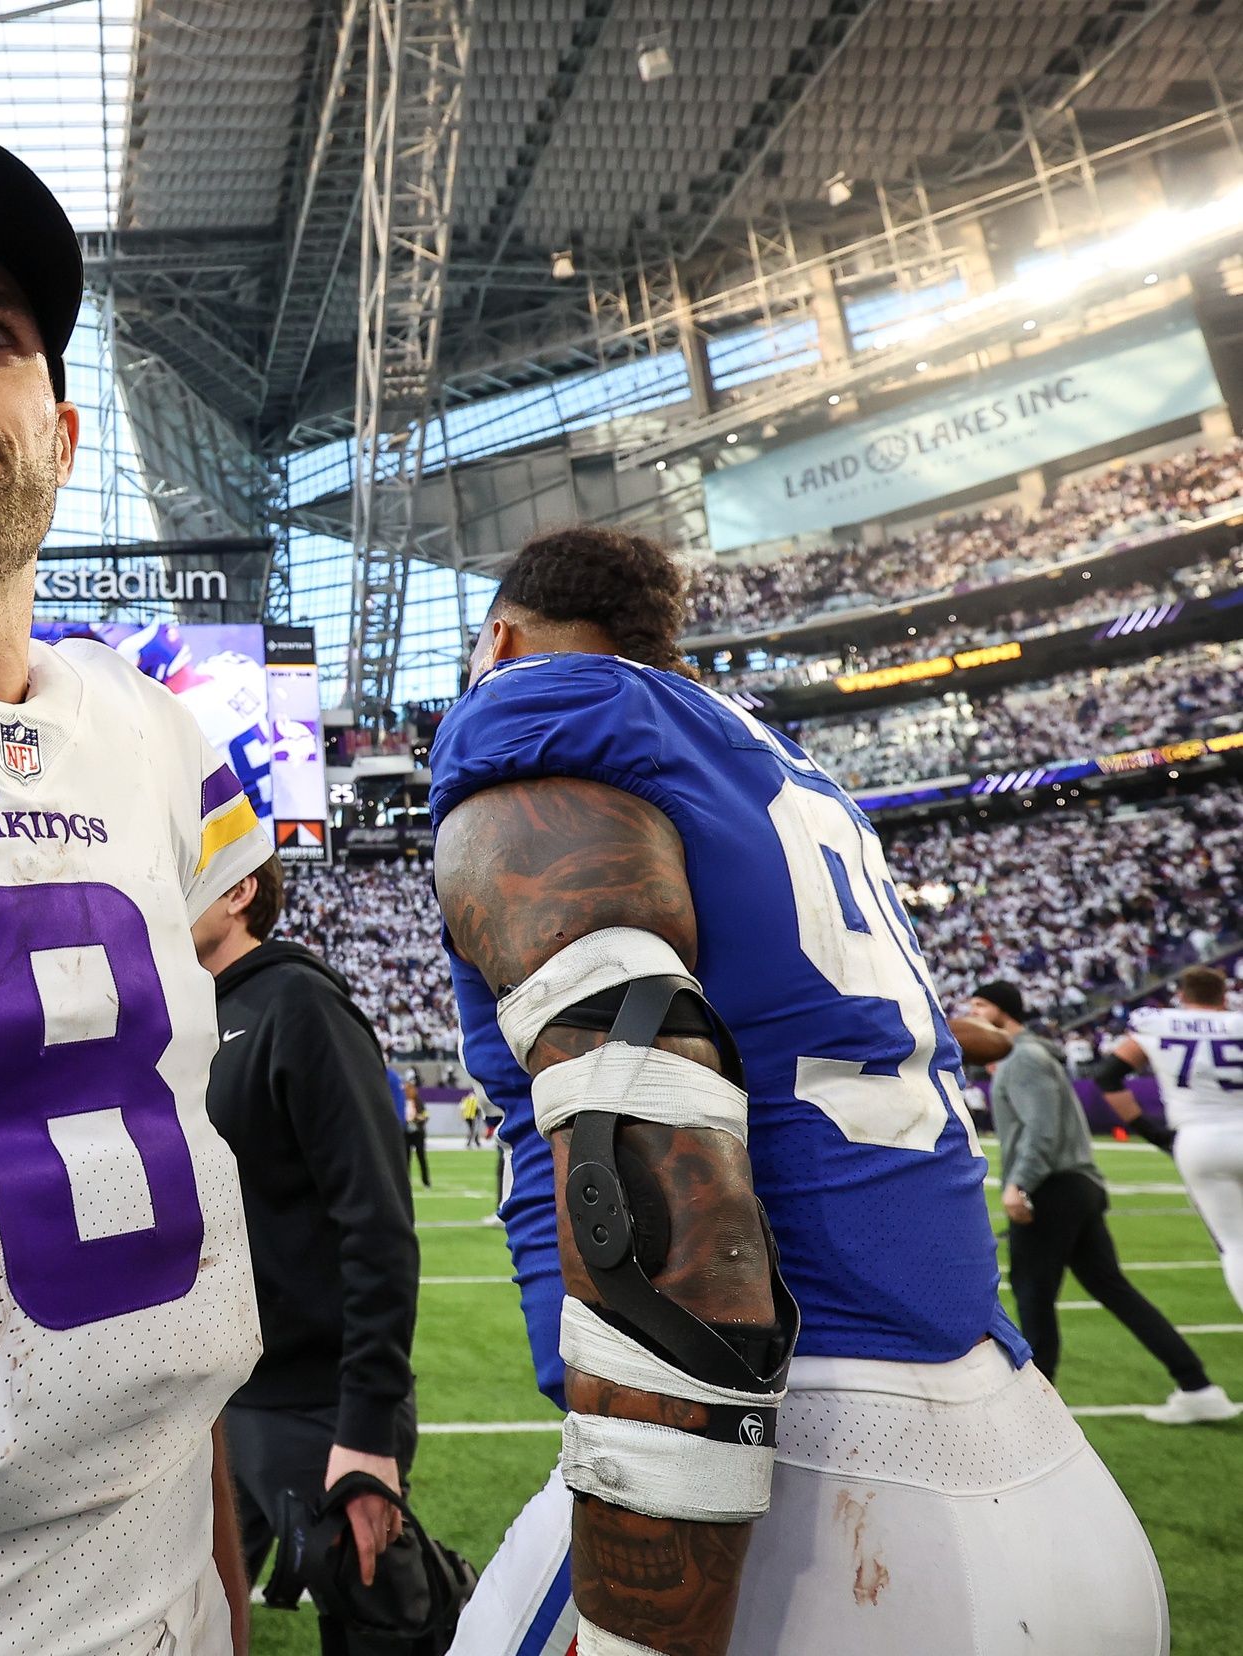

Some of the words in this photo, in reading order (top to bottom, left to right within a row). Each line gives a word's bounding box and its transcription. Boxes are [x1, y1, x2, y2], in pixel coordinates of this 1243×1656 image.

[783, 455, 859, 499] LAND
[914, 399, 1009, 454] LAKES
[1015, 375, 1091, 419] INC.
[34, 563, 228, 600] kstadium
[5, 743, 39, 773] NFL
[1159, 1037, 1243, 1092] 75
